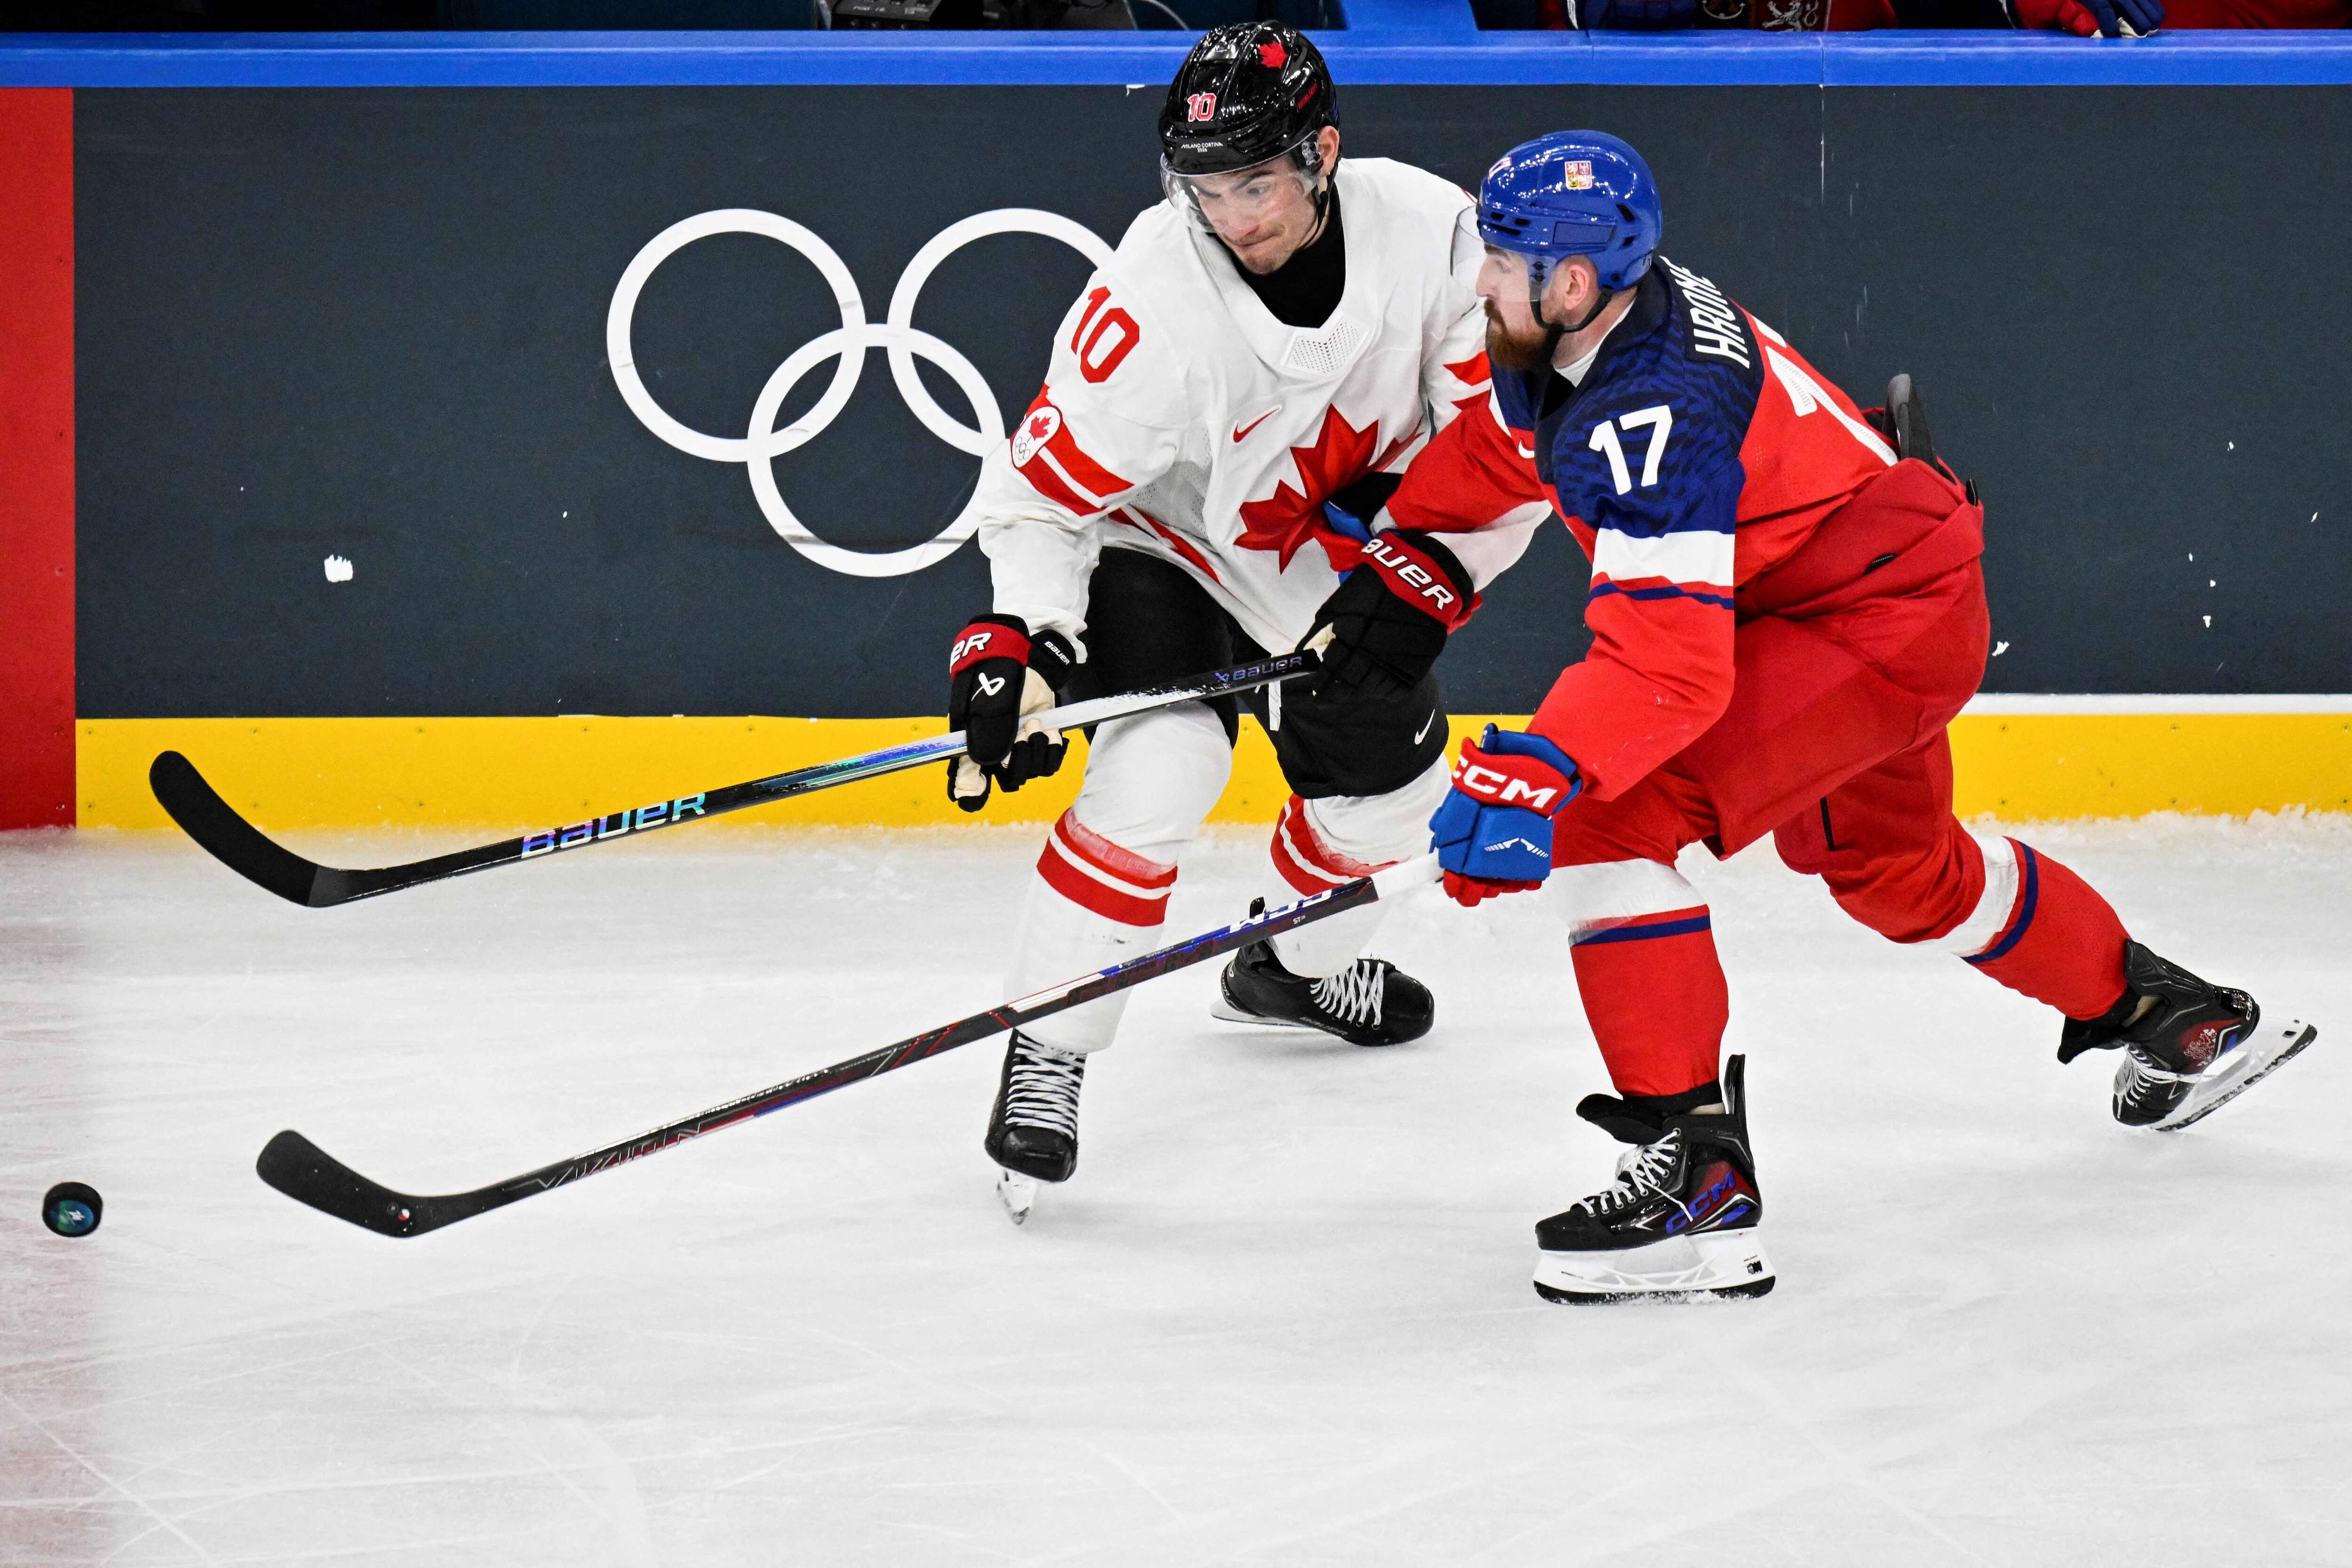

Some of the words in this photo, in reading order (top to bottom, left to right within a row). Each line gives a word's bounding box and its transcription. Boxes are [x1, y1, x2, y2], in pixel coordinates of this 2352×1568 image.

[1187, 93, 1217, 122] 10
[1071, 286, 1140, 383] 10
[1589, 404, 1673, 496] 17
[1044, 641, 1071, 665] BAUER
[1232, 655, 1303, 681] BAUER
[521, 792, 706, 859] BAUER
[1665, 1170, 1736, 1235] CCM
